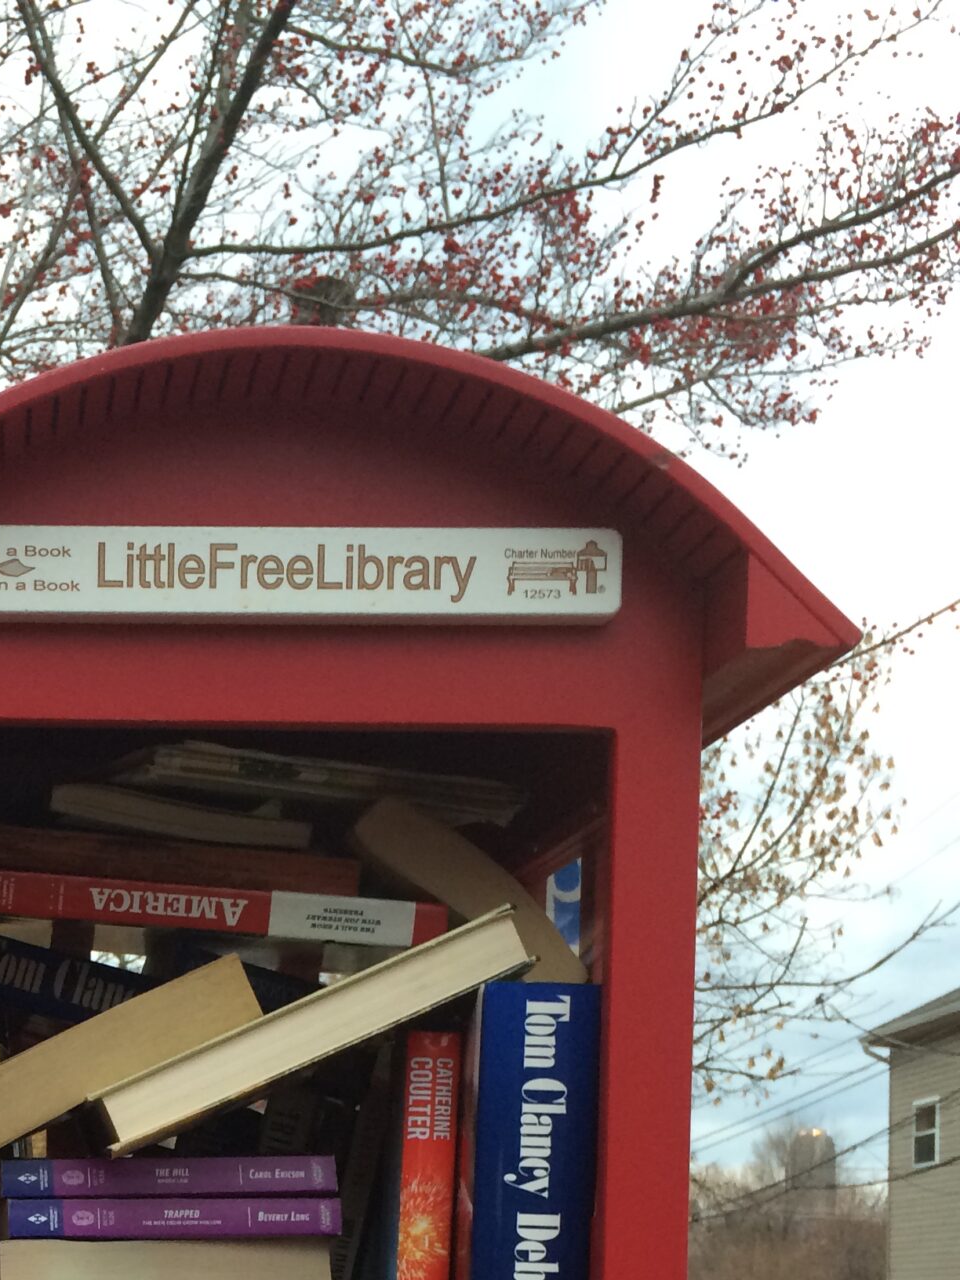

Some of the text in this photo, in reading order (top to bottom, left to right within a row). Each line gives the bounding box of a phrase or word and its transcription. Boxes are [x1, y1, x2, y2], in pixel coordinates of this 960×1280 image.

[6, 547, 17, 557] a
[24, 545, 72, 558] Book
[96, 541, 477, 602] LittleFreeLibrary
[504, 548, 577, 559] Charter Number
[15, 581, 26, 591] a
[33, 579, 81, 592] Book
[523, 589, 562, 600] 12573
[89, 887, 249, 927] AMERICA
[523, 995, 571, 1069] Tom
[407, 1057, 433, 1140] COULTER
[433, 1058, 453, 1141] CATHERINE
[503, 1077, 568, 1199] Clancy
[164, 1209, 200, 1219] TRAPPED
